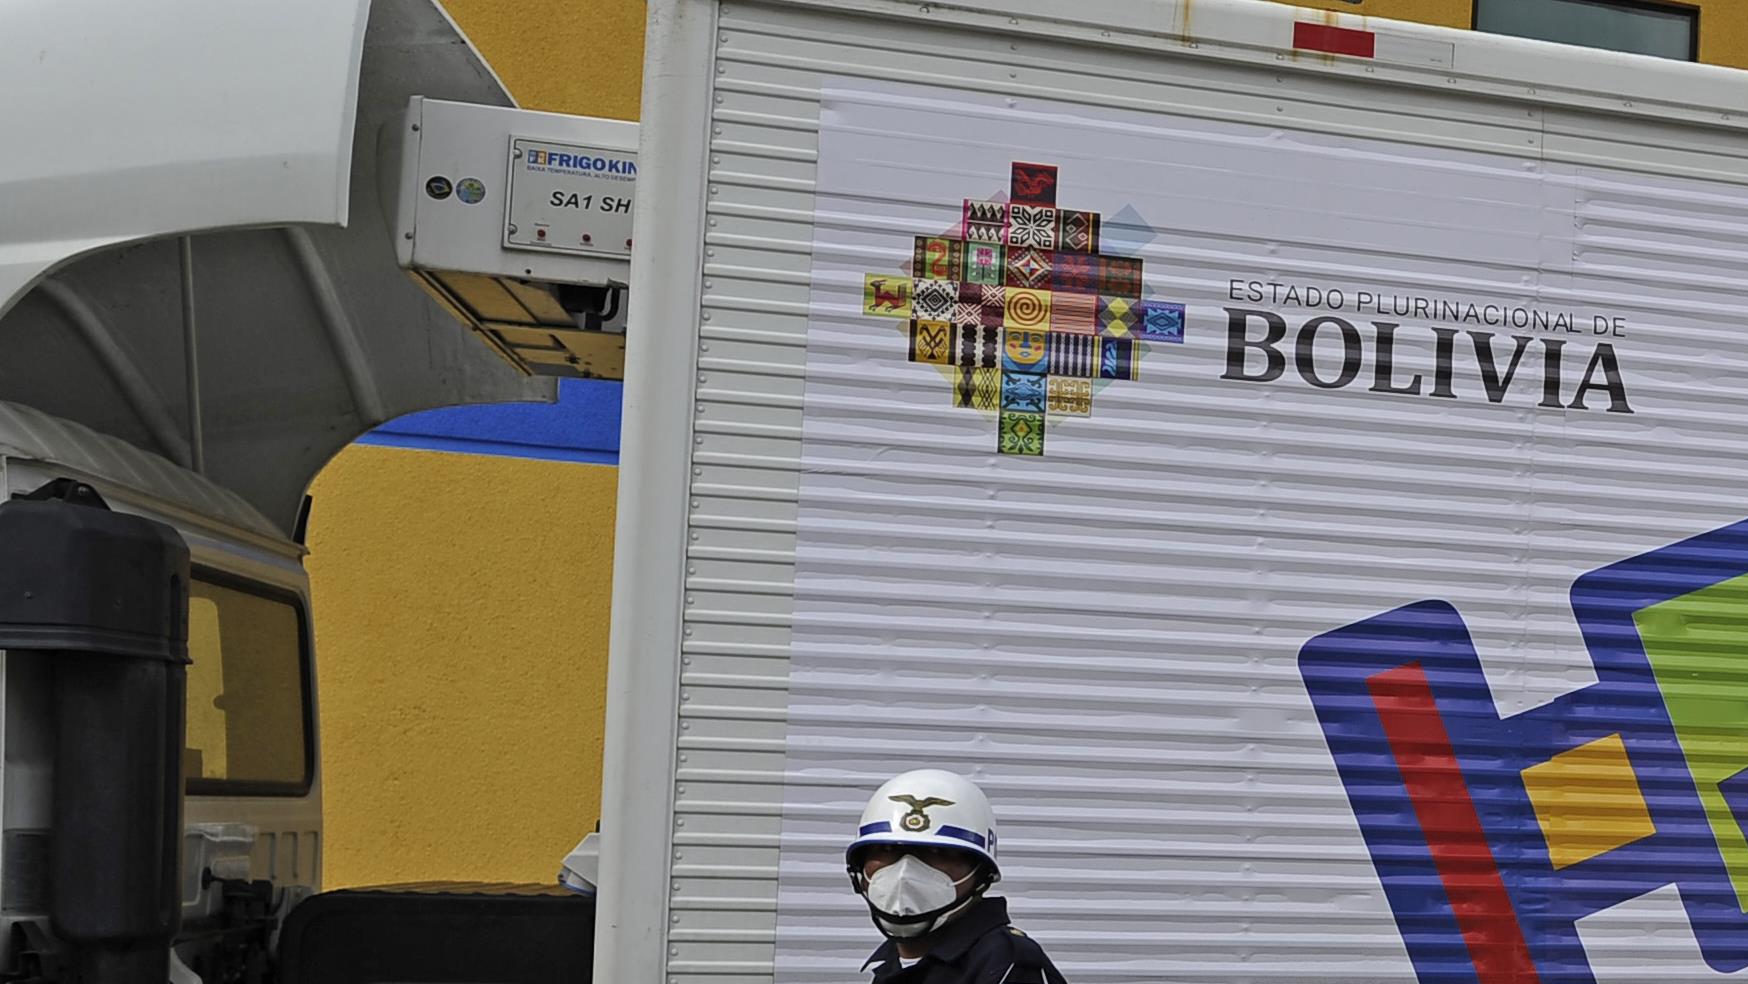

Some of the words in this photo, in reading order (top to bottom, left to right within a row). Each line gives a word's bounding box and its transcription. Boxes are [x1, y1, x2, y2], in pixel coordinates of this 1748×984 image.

[550, 191, 593, 210] SA1
[600, 196, 631, 214] SH
[1228, 278, 1345, 309] ESTADO
[1356, 291, 1582, 334] PLURINACIONAL
[1593, 315, 1627, 338] DE
[1219, 306, 1635, 414] BOLIVIA
